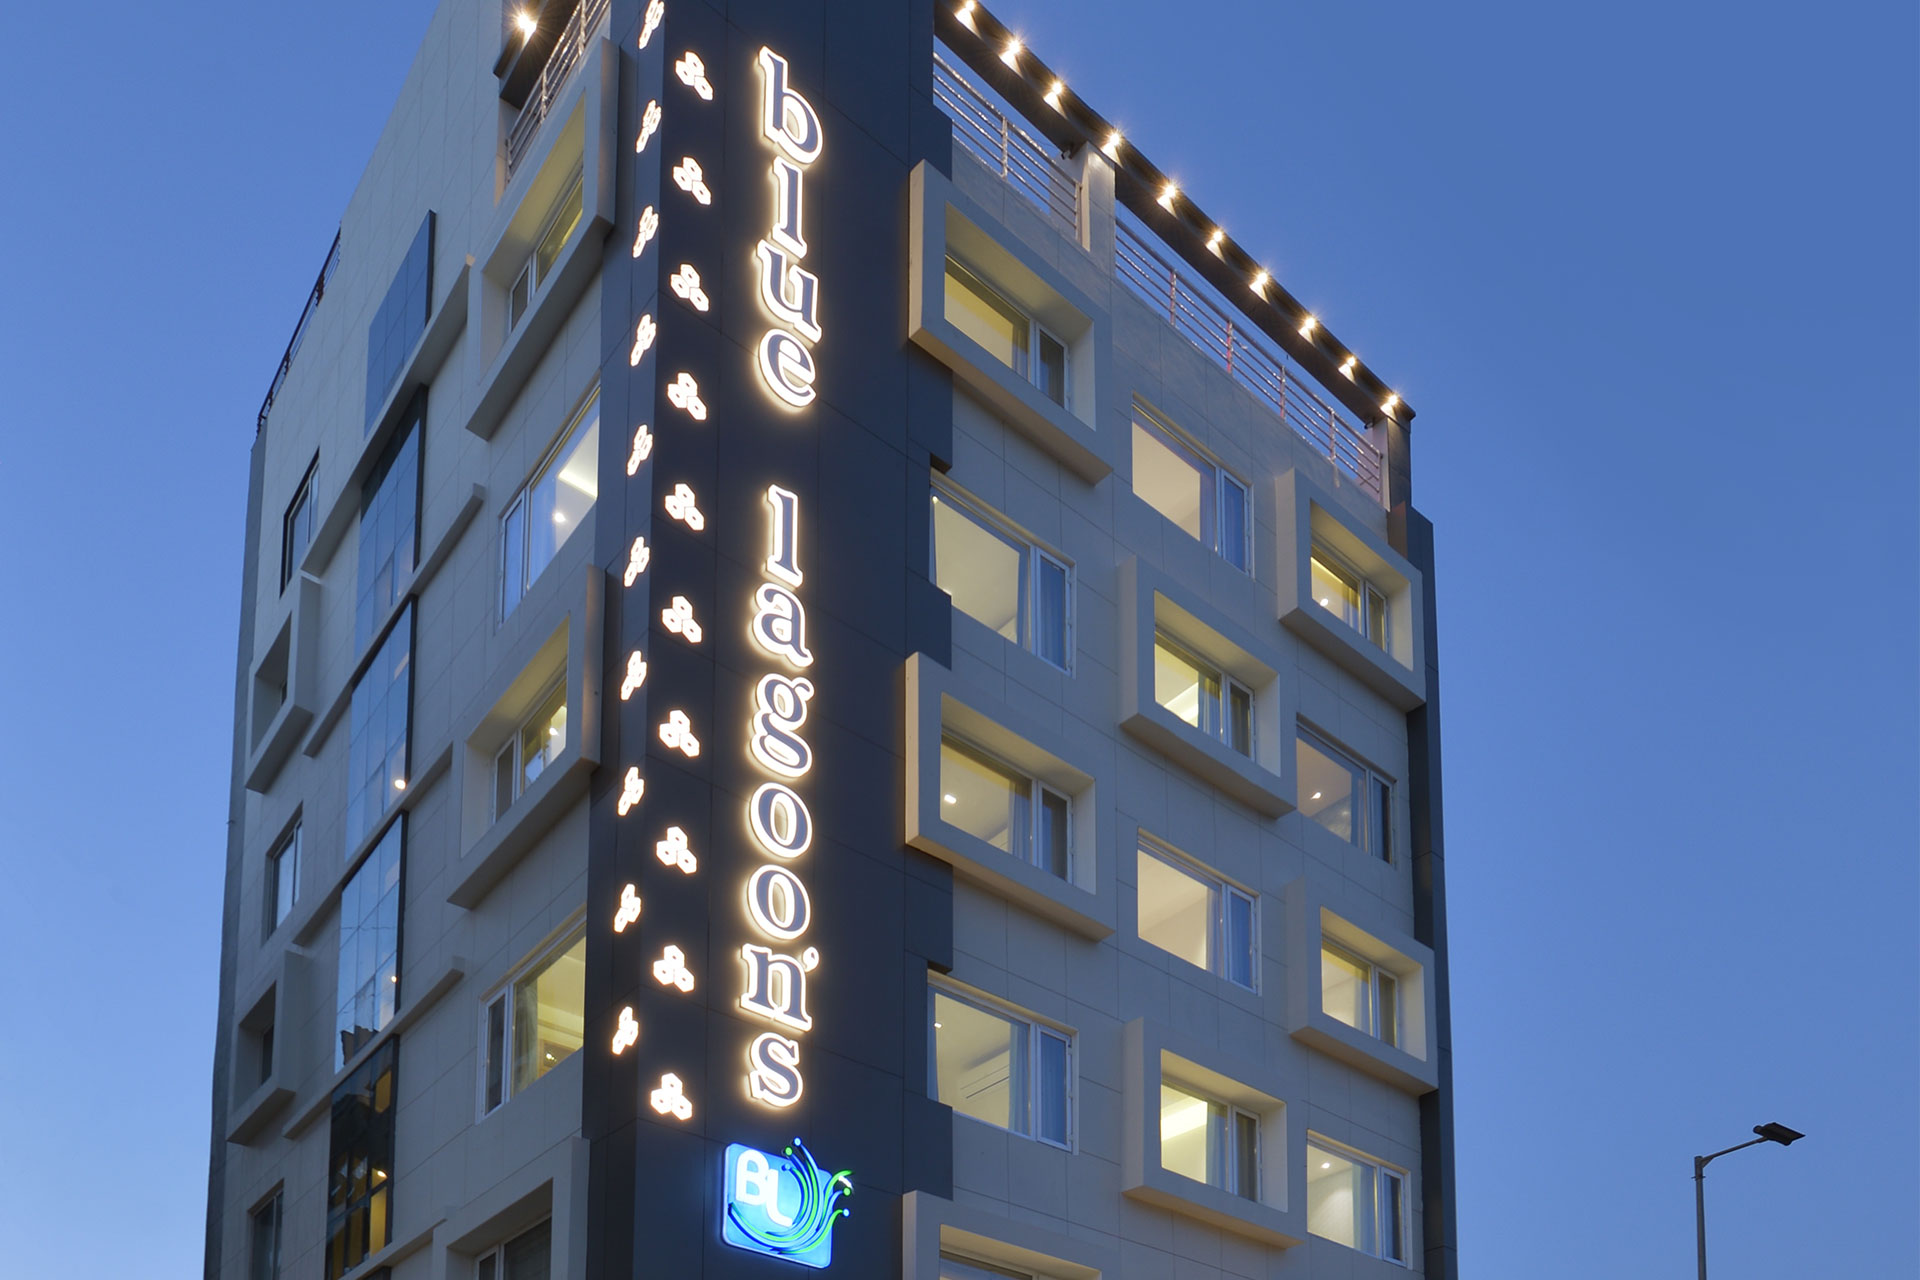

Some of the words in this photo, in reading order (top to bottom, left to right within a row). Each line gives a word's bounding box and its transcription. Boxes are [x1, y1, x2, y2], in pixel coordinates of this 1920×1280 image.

[757, 45, 823, 407] blue
[739, 484, 820, 1107] lagoon's
[735, 1149, 793, 1227] BL
